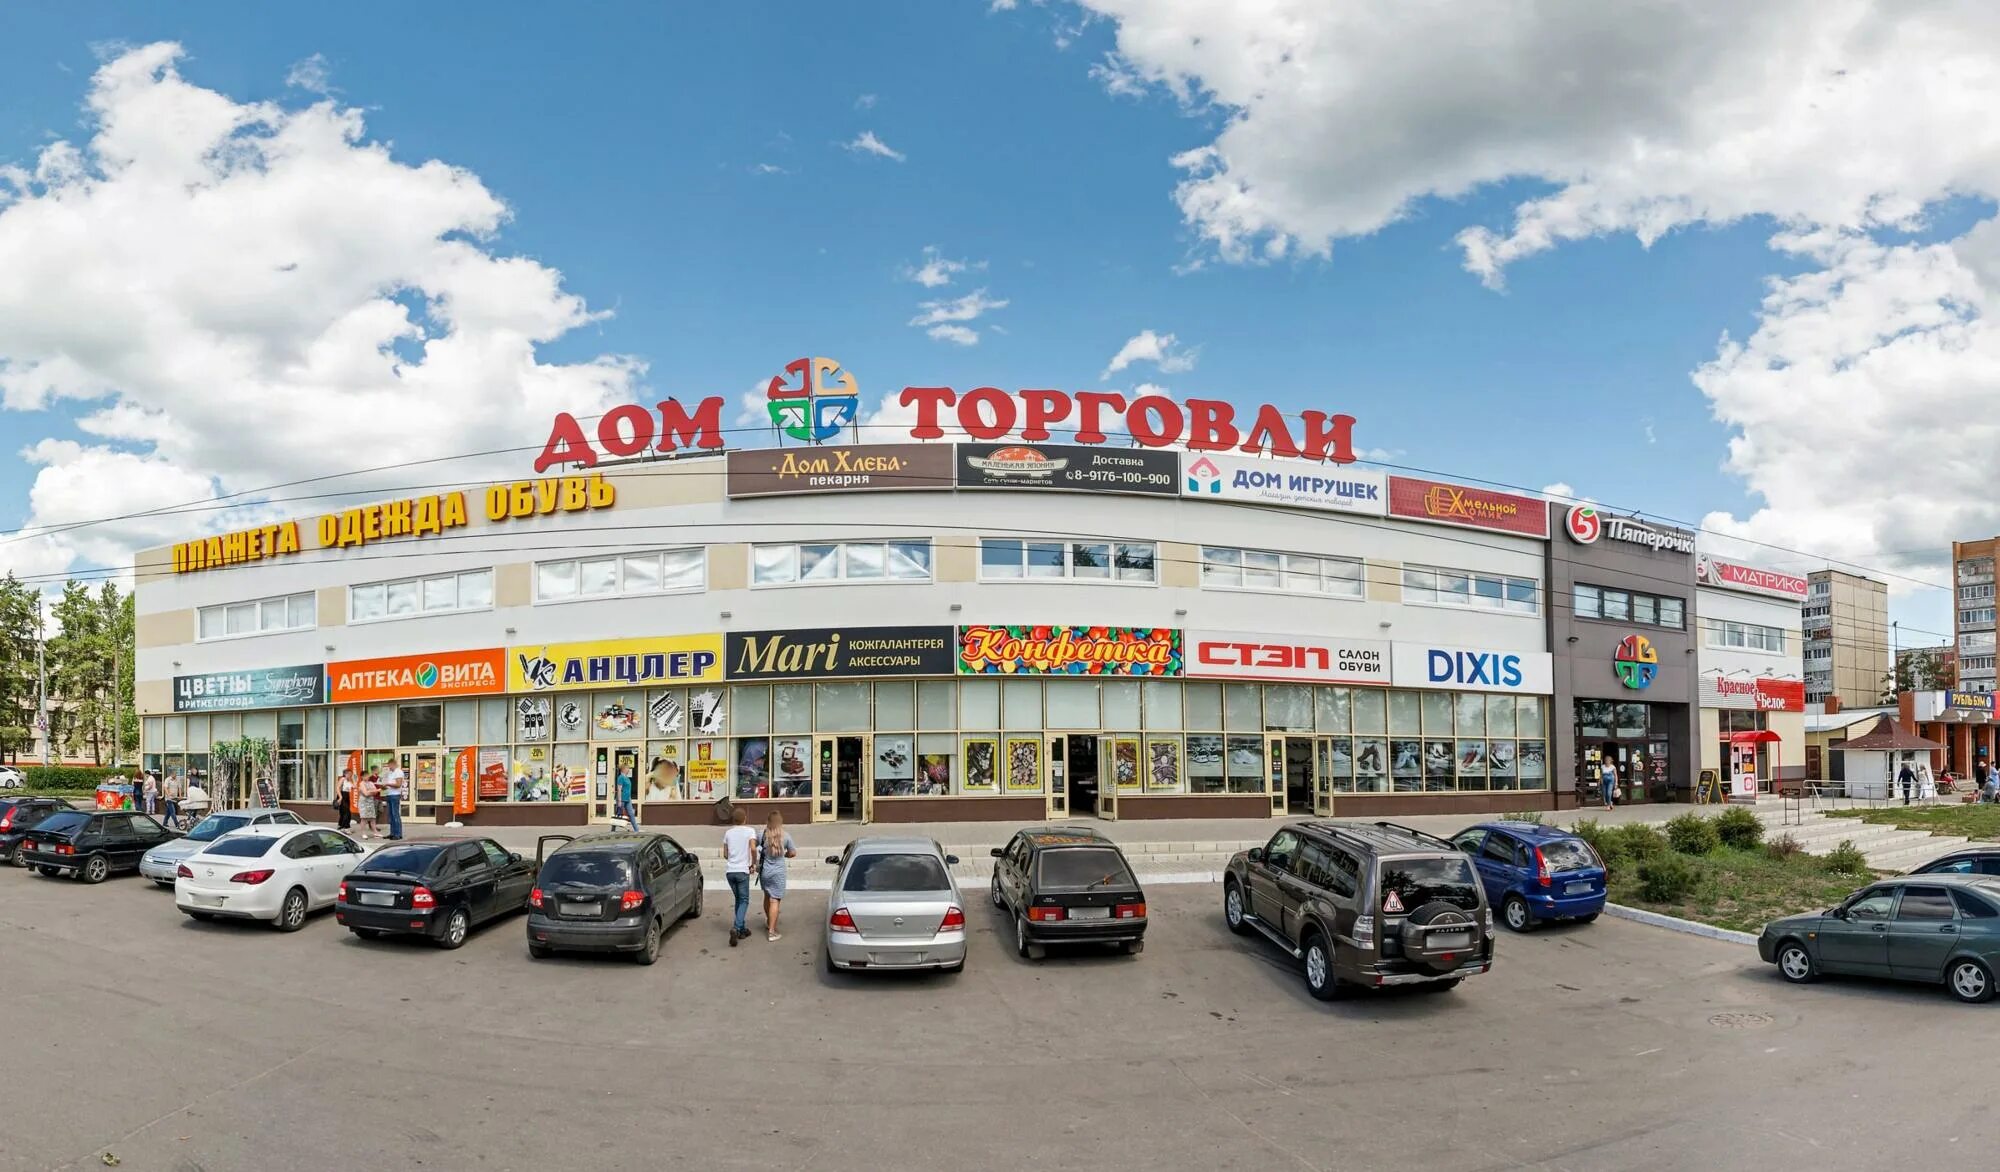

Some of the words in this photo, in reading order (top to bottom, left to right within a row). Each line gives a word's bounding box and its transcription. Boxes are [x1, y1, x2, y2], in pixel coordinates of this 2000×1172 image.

[534, 396, 725, 474] ДОМ
[900, 386, 1357, 463] ТОРГОВЛИ
[981, 460, 1025, 469] МАЛЕНЬКАЯ
[1092, 454, 1144, 467] Доставка
[809, 474, 870, 487] пекарня
[1074, 469, 1170, 485] 8-9176-100-900
[1232, 469, 1282, 489] ДОМ
[1288, 475, 1379, 501] ИГРУШЕК
[1449, 490, 1518, 515] Хмельной
[172, 521, 301, 573] ПЛАНЕТА
[318, 491, 468, 548] ОДЕЖДА
[486, 472, 616, 522] ОБУВЬ
[1733, 567, 1805, 593] МАТРИКС
[734, 632, 841, 674] Mari
[849, 639, 944, 650] КОЖГАЛАНТЕРЕЯ
[961, 627, 1173, 669] Конфетка
[1199, 641, 1329, 670] СТЭП
[1338, 649, 1380, 661] САЛОН
[849, 655, 921, 667] АКСЕССУАРЫ
[1339, 661, 1381, 672] ОБУВИ
[1428, 649, 1522, 687] DIXIS
[264, 672, 318, 698] Symphony
[338, 668, 415, 691] АПТЕКА
[440, 662, 495, 682] ВИТА
[440, 679, 496, 689] ЭКСПРЕСС
[1717, 676, 1755, 697] Красное
[1761, 692, 1786, 709] Белое
[1952, 693, 1973, 706] РУБЛЬ
[664, 744, 677, 754] -20%
